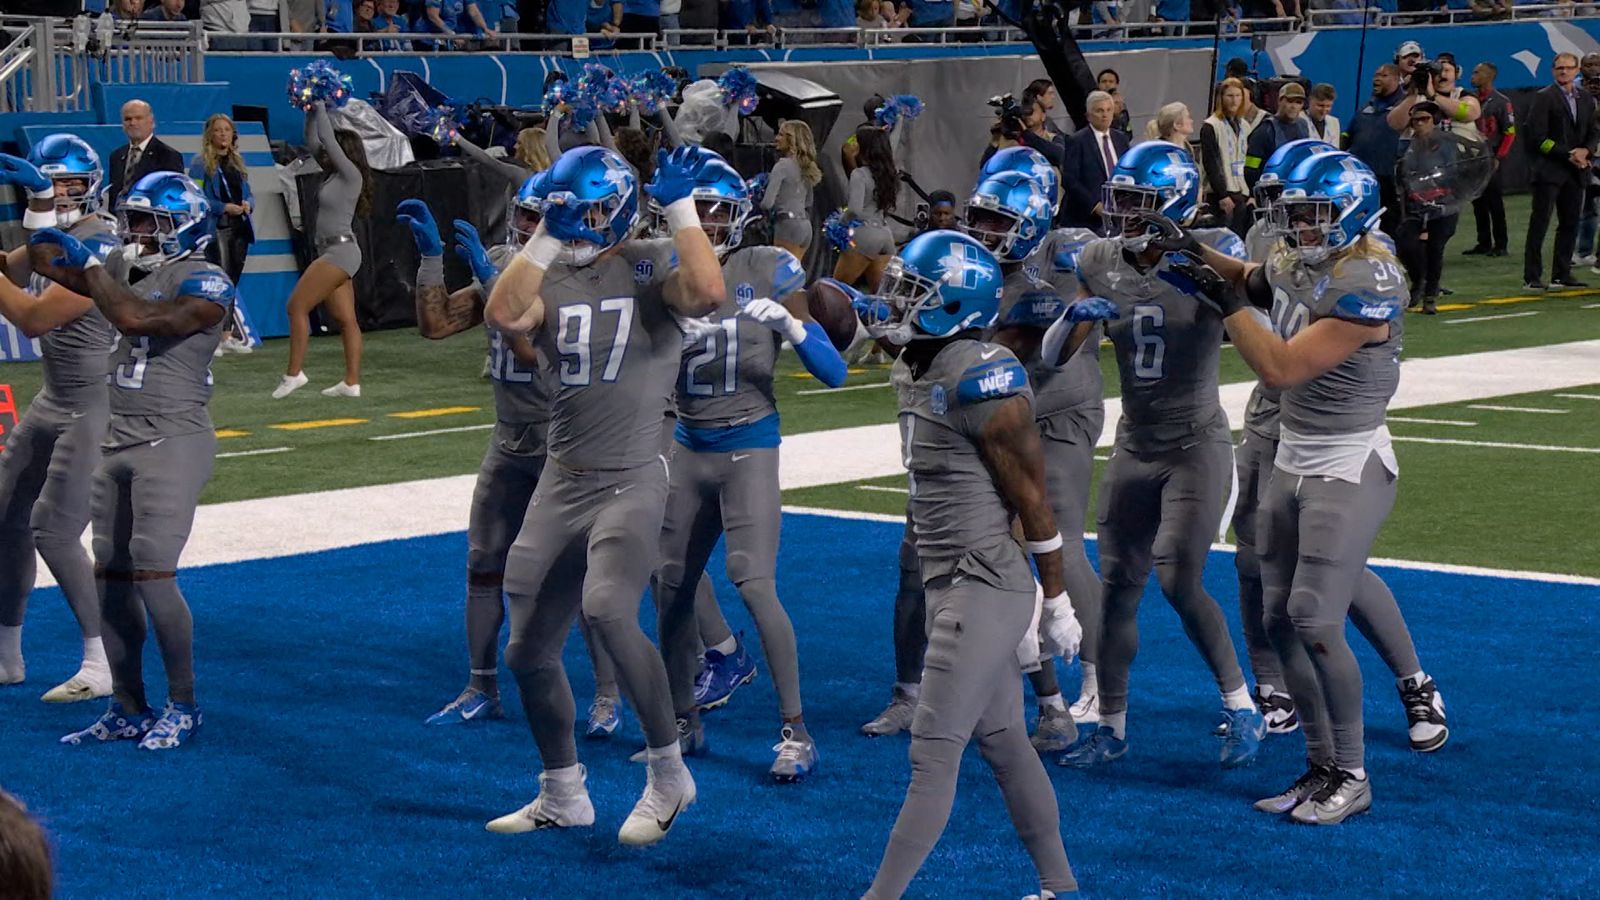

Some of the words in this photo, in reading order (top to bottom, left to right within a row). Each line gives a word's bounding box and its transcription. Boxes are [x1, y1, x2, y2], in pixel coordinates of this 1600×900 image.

[556, 295, 634, 386] 97
[685, 316, 738, 397] 21
[1133, 304, 1166, 380] 6
